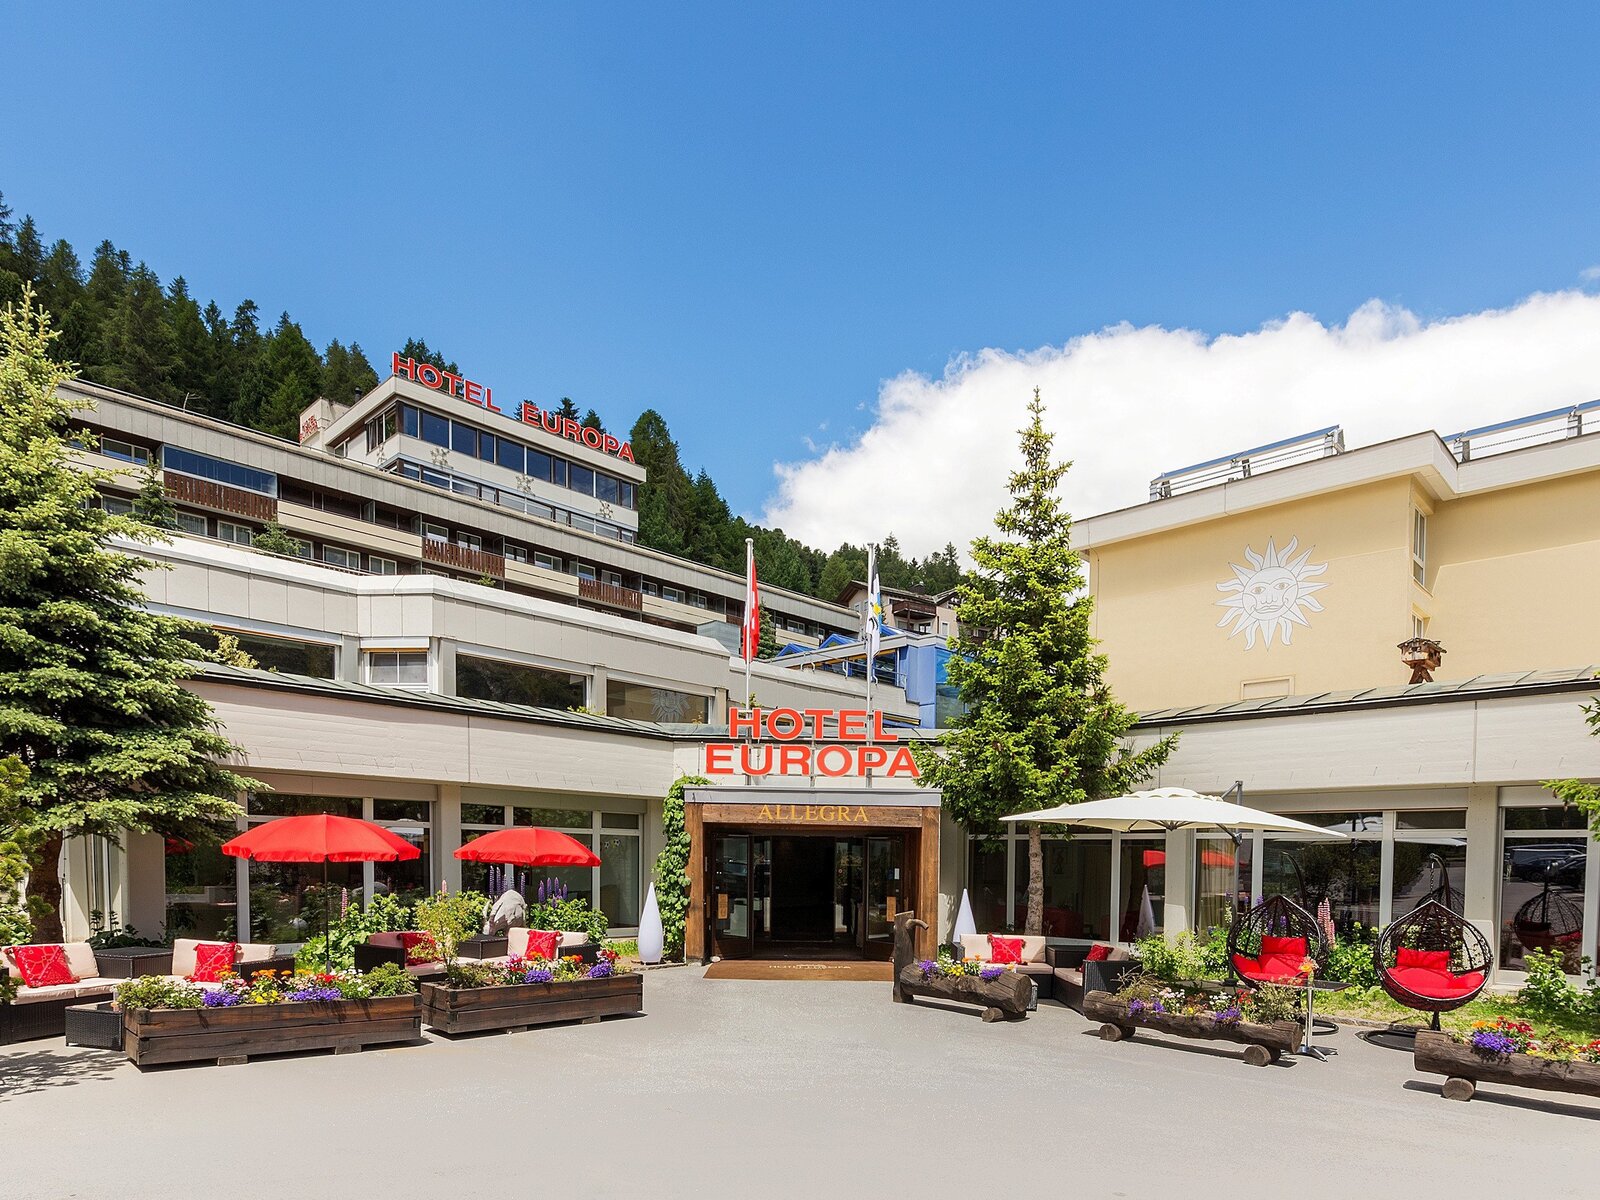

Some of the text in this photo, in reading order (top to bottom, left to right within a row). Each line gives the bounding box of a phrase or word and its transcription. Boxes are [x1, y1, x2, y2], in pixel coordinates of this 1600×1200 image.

[392, 352, 635, 463] HOTEL EUROPA
[729, 707, 898, 742] HOTEL
[705, 743, 921, 777] EUROPA
[758, 804, 869, 822] ALLEGRA
